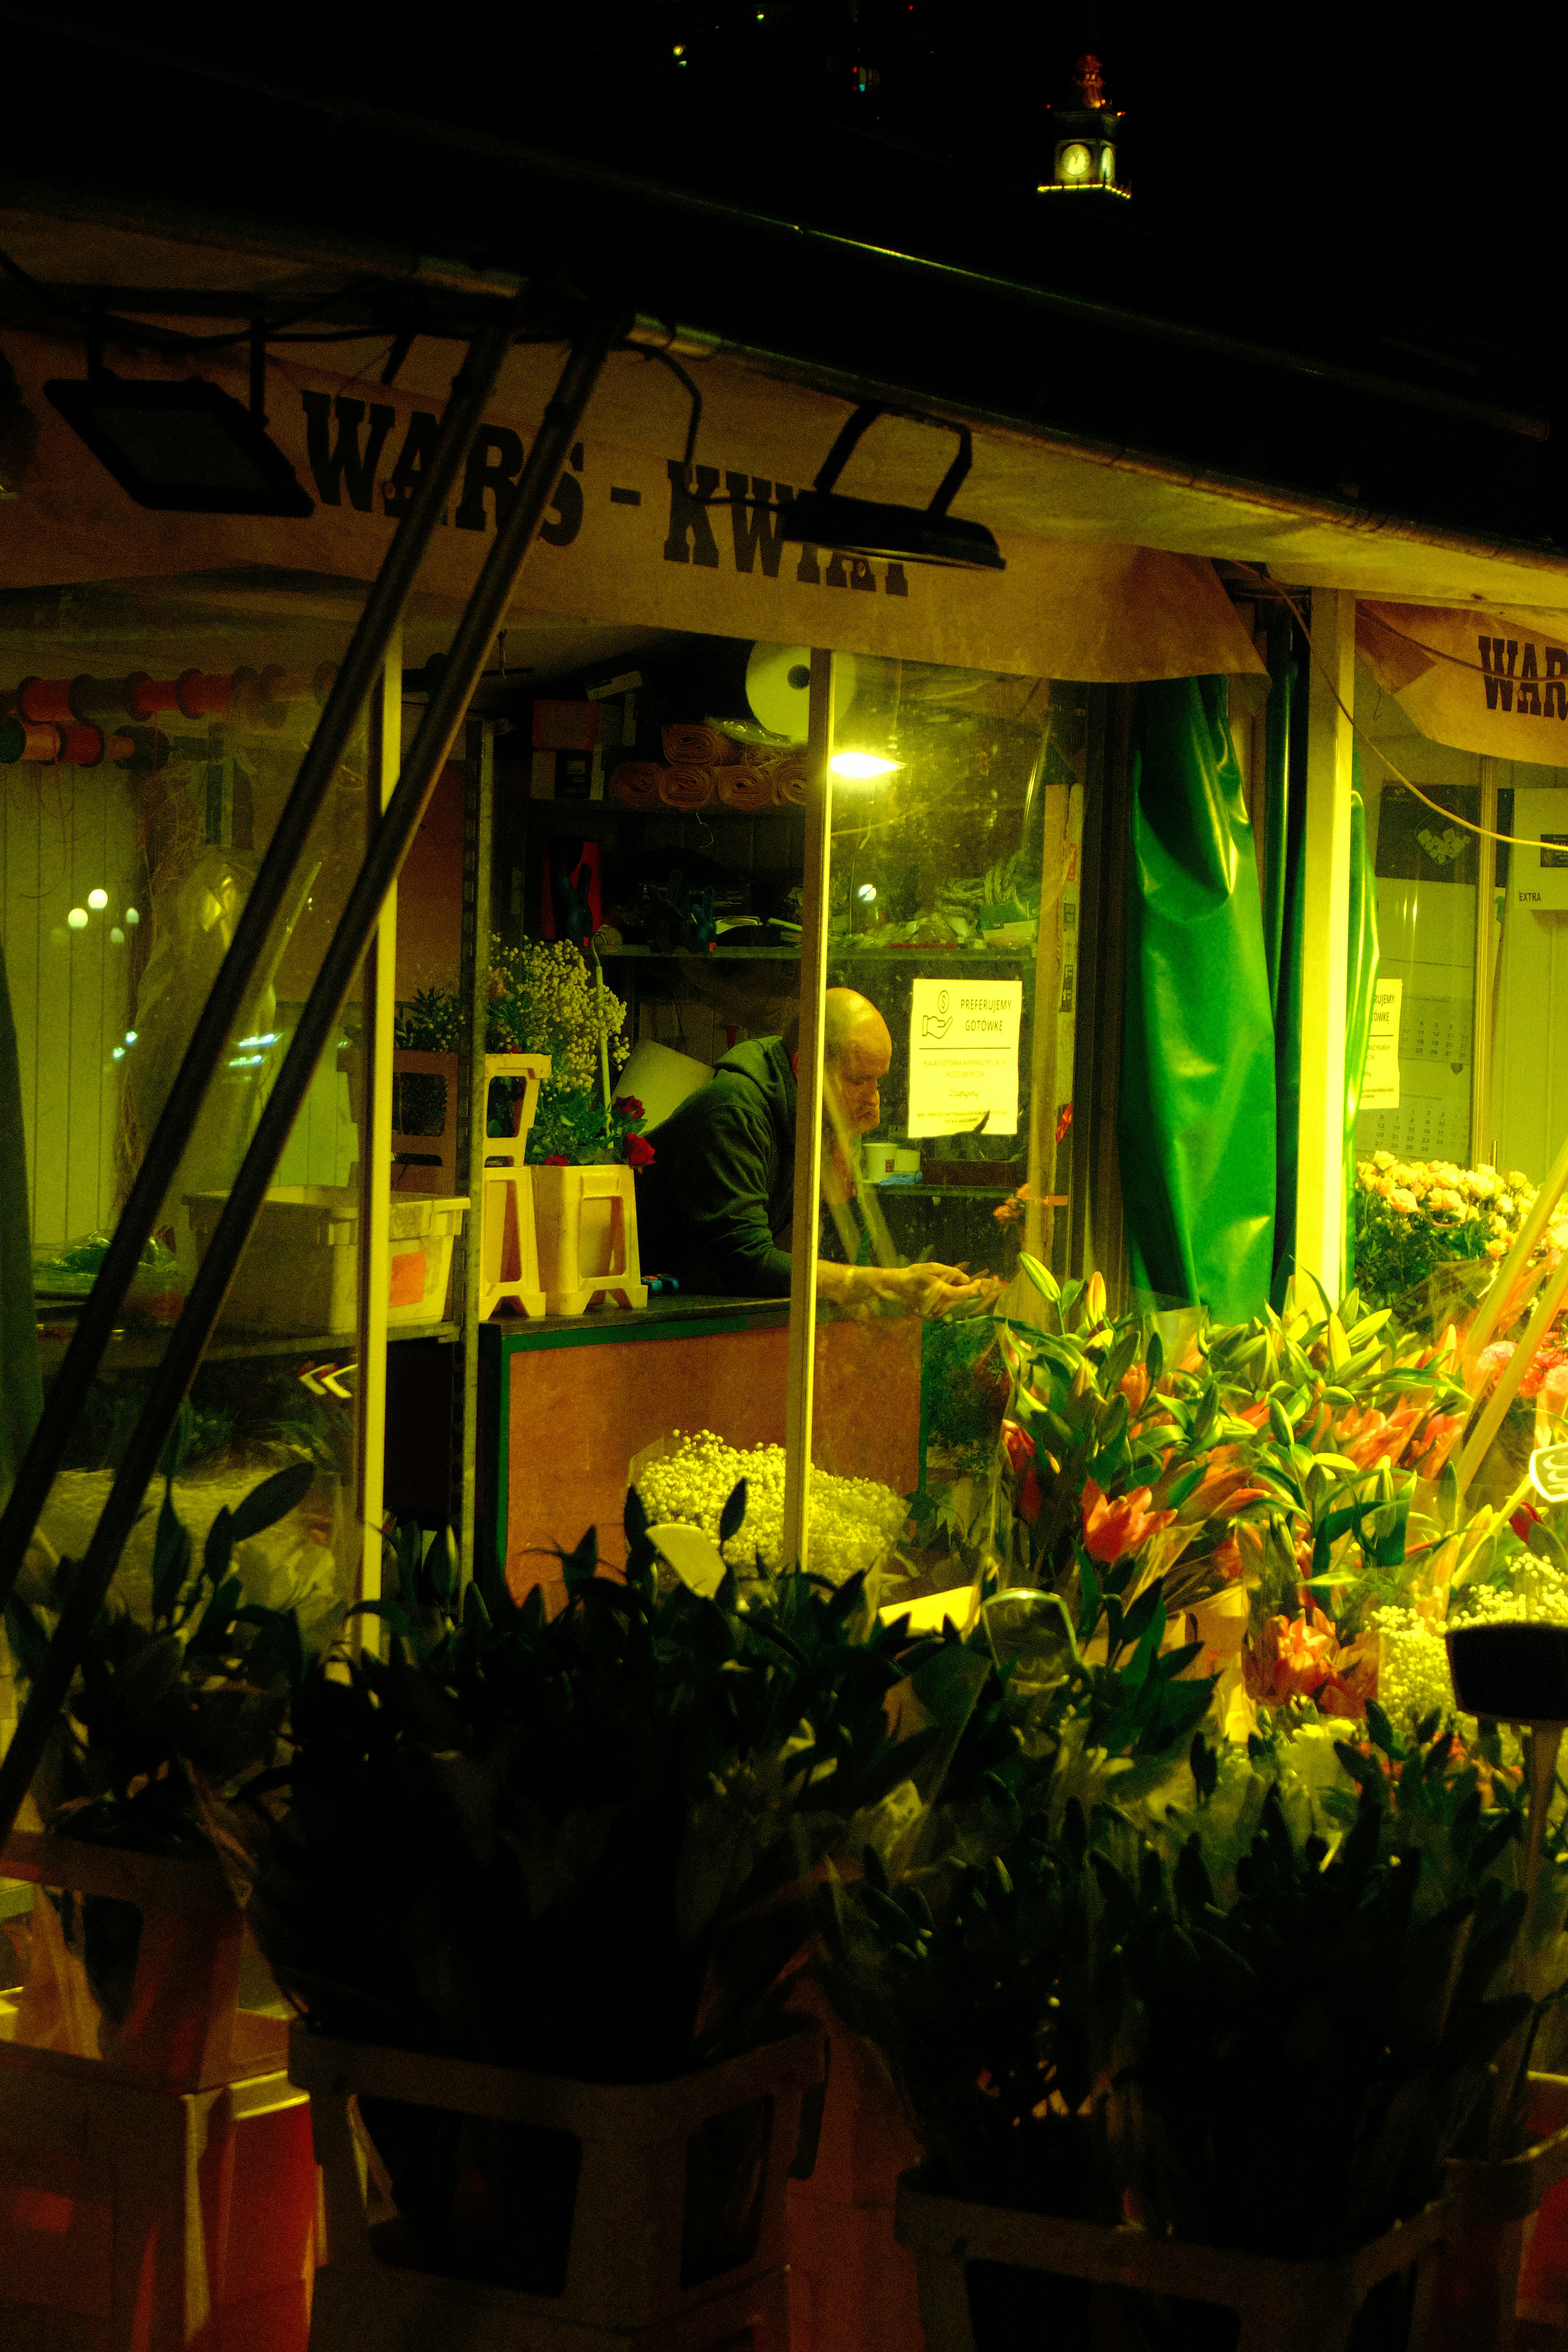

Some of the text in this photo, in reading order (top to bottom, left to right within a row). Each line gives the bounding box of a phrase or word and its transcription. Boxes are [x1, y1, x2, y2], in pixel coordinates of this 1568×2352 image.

[1519, 892, 1541, 902] EXTRA
[961, 999, 1012, 1013] PREFERUJEMY
[965, 1018, 1003, 1034] GOTÓWKĘ
